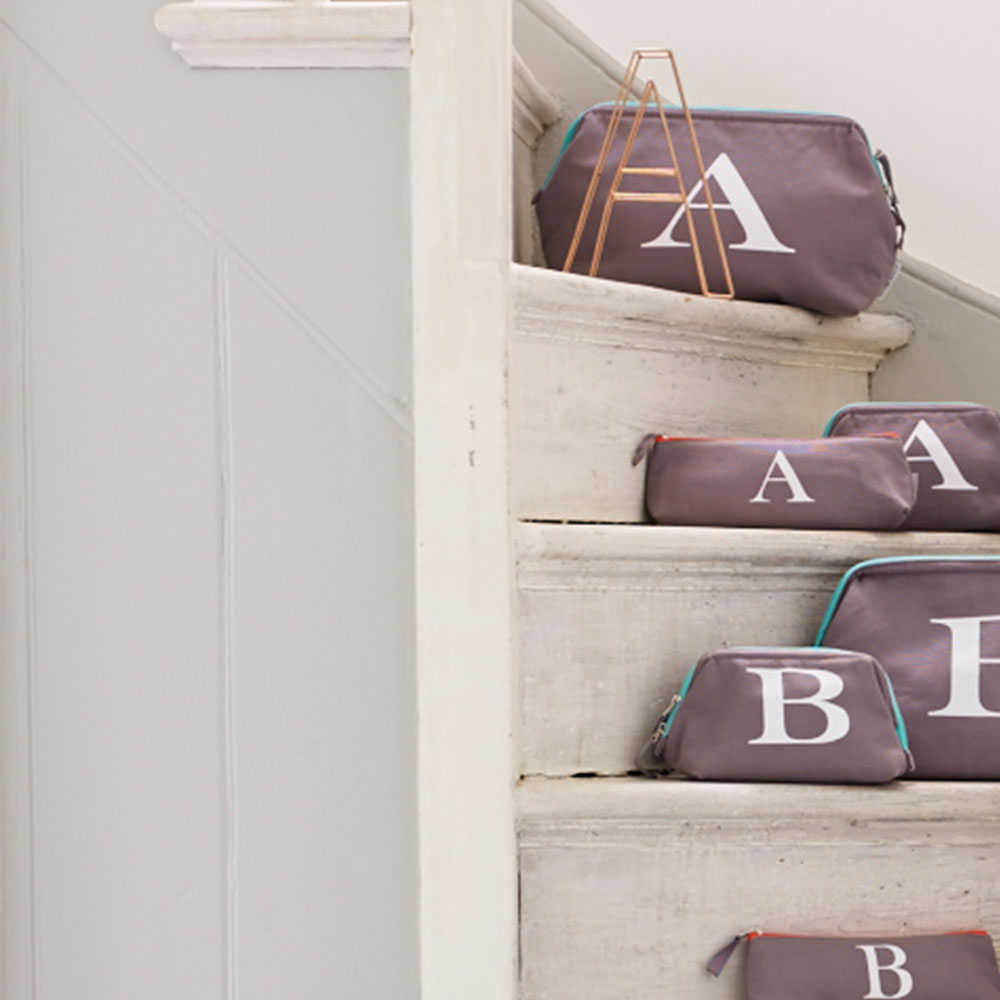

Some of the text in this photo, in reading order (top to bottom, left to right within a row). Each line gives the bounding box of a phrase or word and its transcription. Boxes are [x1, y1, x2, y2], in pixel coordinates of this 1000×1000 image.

[564, 49, 734, 299] A
[641, 152, 796, 254] A
[749, 449, 815, 503] A
[903, 418, 978, 491] A
[746, 666, 851, 745] B
[856, 944, 913, 1000] B
